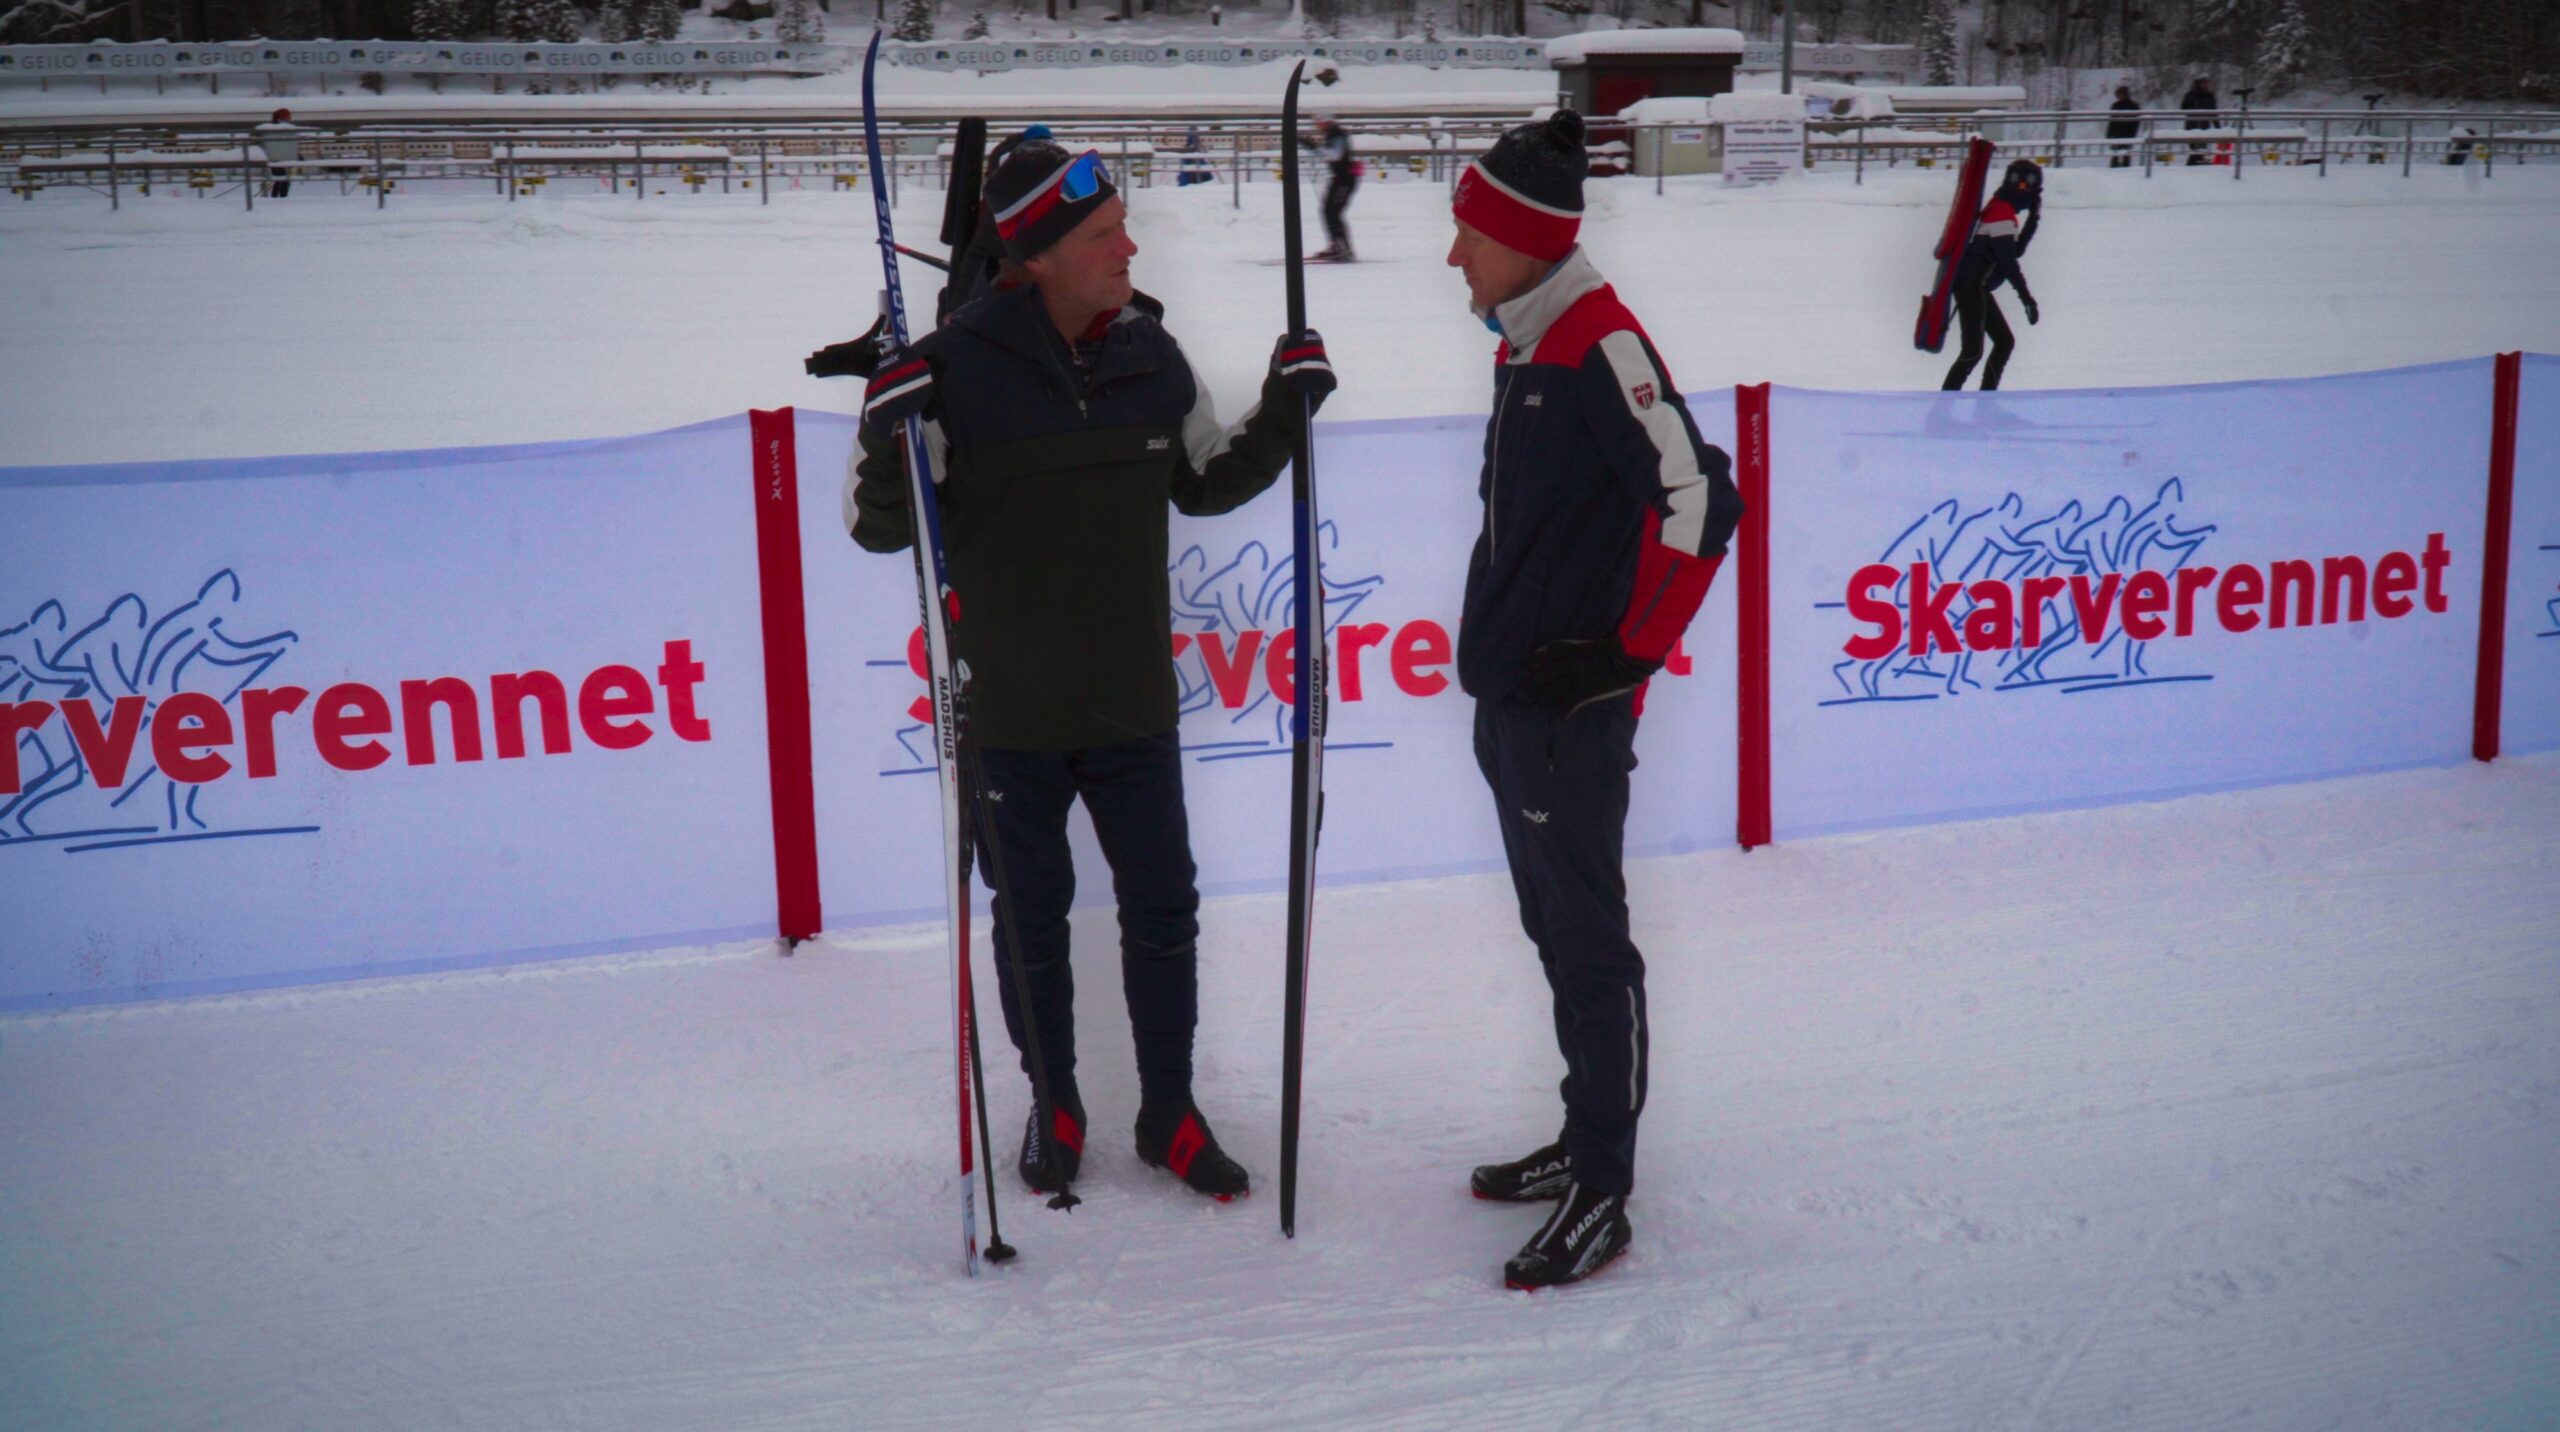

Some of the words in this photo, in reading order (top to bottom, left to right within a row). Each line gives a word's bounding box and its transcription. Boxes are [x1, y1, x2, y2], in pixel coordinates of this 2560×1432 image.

[22, 55, 77, 69] GEILO
[111, 54, 166, 67] GEILO
[286, 51, 340, 65] GEILO
[460, 52, 516, 66] GEILO
[547, 52, 600, 66] GEILO
[632, 52, 685, 66] GEILO
[716, 51, 767, 64] GEILO
[957, 51, 1005, 64] GEILO
[1033, 50, 1081, 63] GEILO
[1110, 50, 1157, 62] GEILO
[1185, 50, 1232, 62] GEILO
[1404, 49, 1448, 62] GEILO
[1474, 49, 1516, 62] GEILO
[1842, 532, 2451, 661] Skarverennet
[1312, 658, 1321, 737] MADSHUS
[938, 676, 954, 760] MADSHUS
